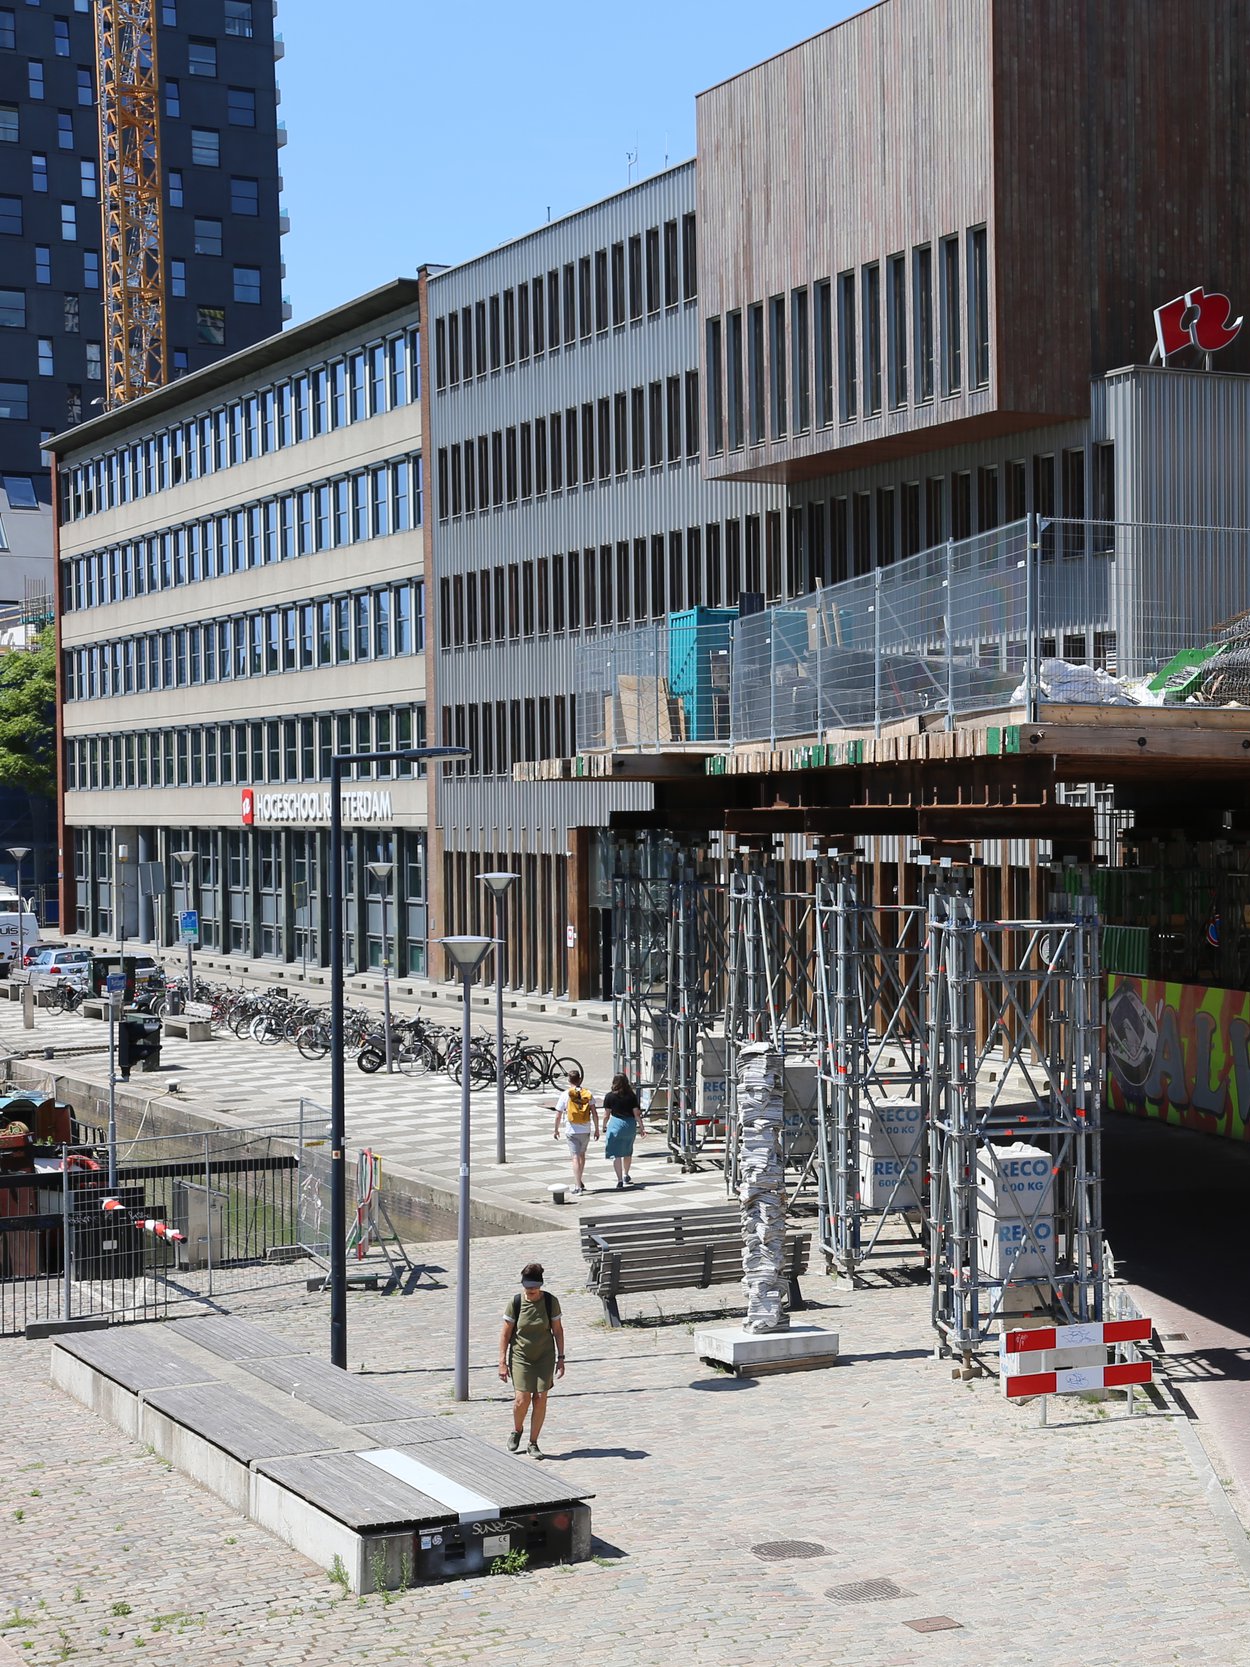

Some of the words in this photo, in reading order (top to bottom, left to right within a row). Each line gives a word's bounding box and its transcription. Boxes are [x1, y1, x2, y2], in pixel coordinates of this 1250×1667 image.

[256, 793, 321, 819] HOGESCHOOL
[323, 791, 393, 818] RTTERDAM
[901, 1126, 916, 1134] KG
[1027, 1181, 1044, 1192] KG
